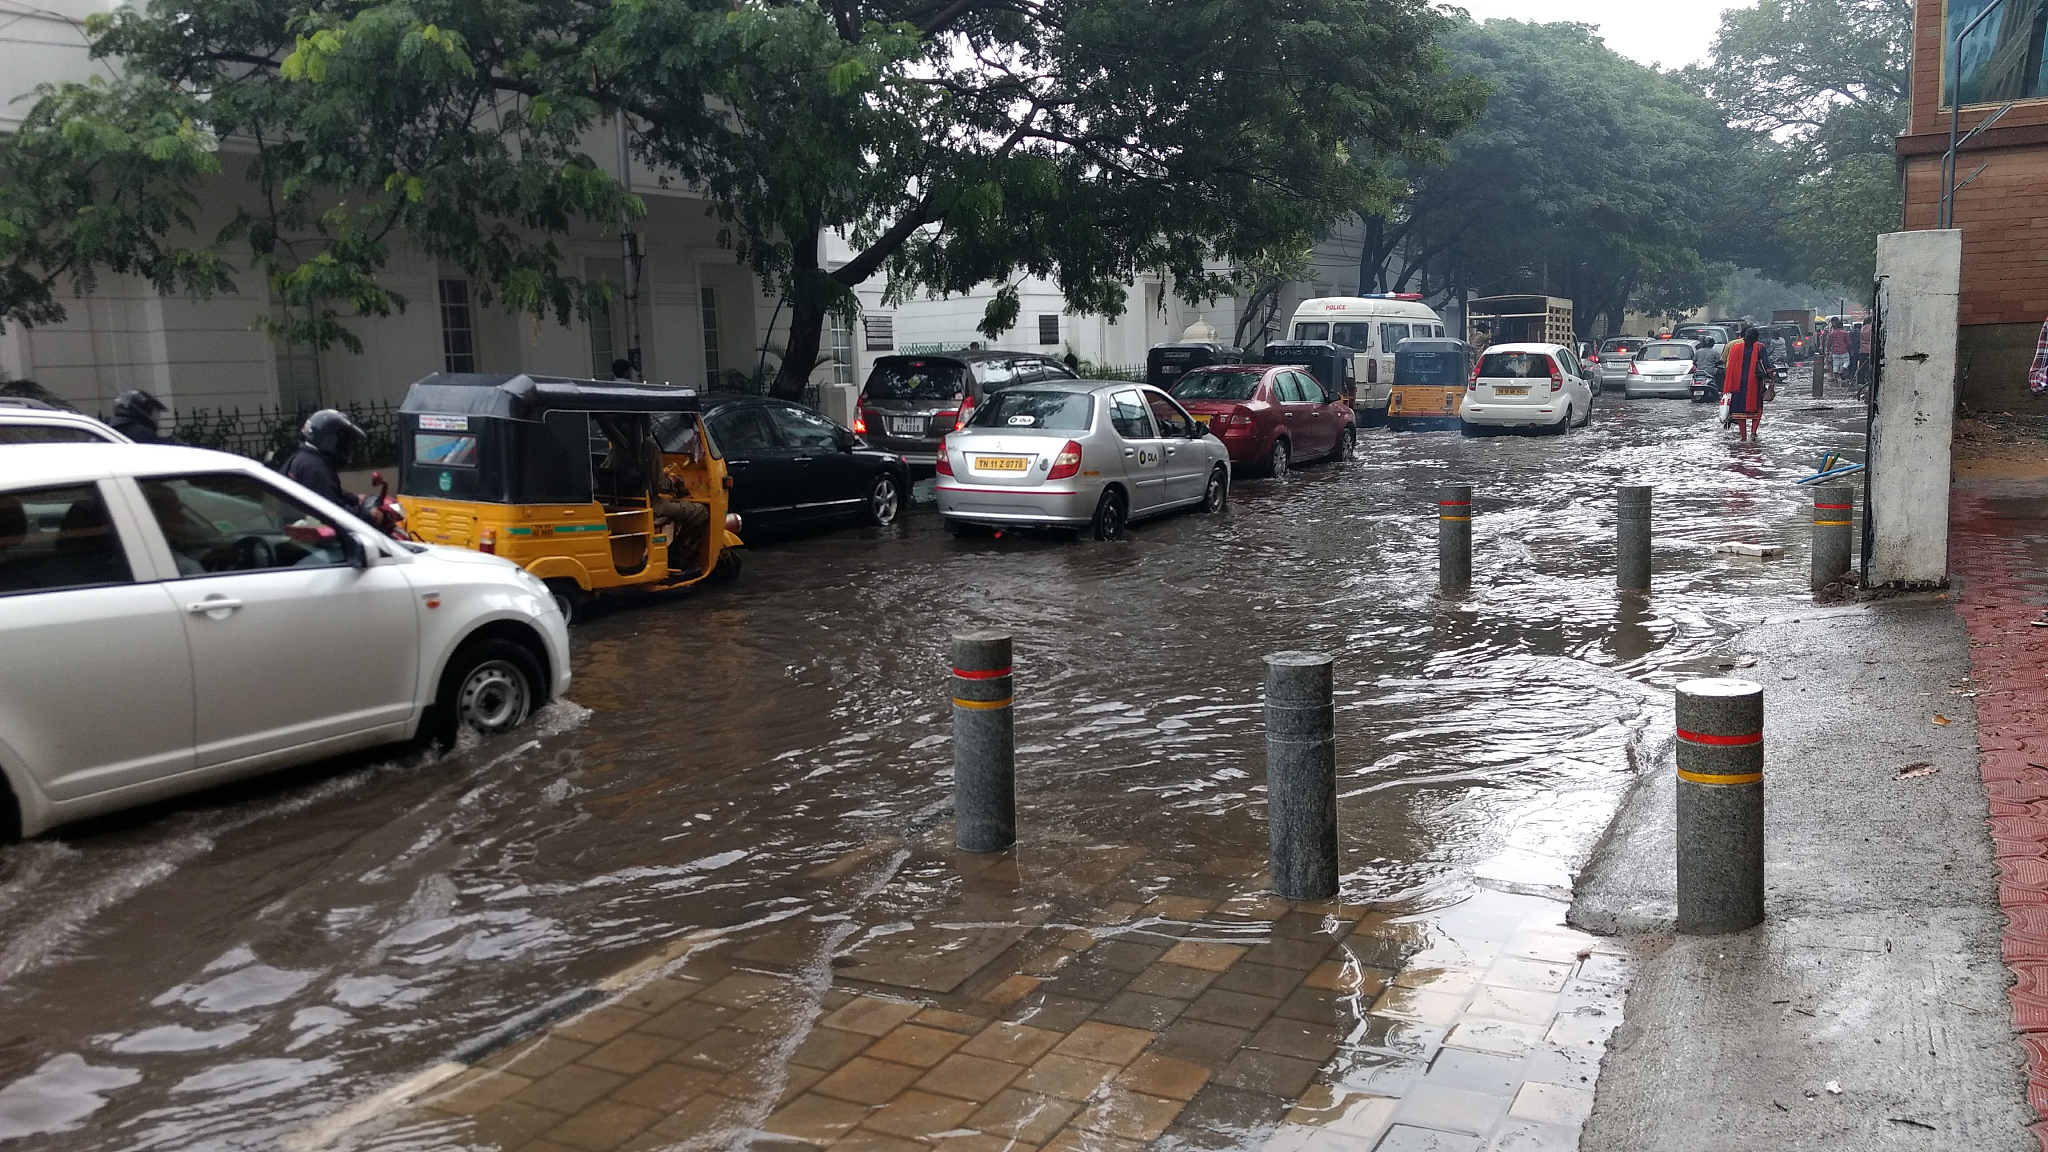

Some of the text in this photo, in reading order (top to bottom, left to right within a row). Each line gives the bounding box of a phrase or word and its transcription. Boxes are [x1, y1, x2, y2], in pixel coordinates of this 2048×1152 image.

[979, 460, 989, 468] TN
[990, 460, 998, 468] 11
[999, 460, 1005, 468] Z
